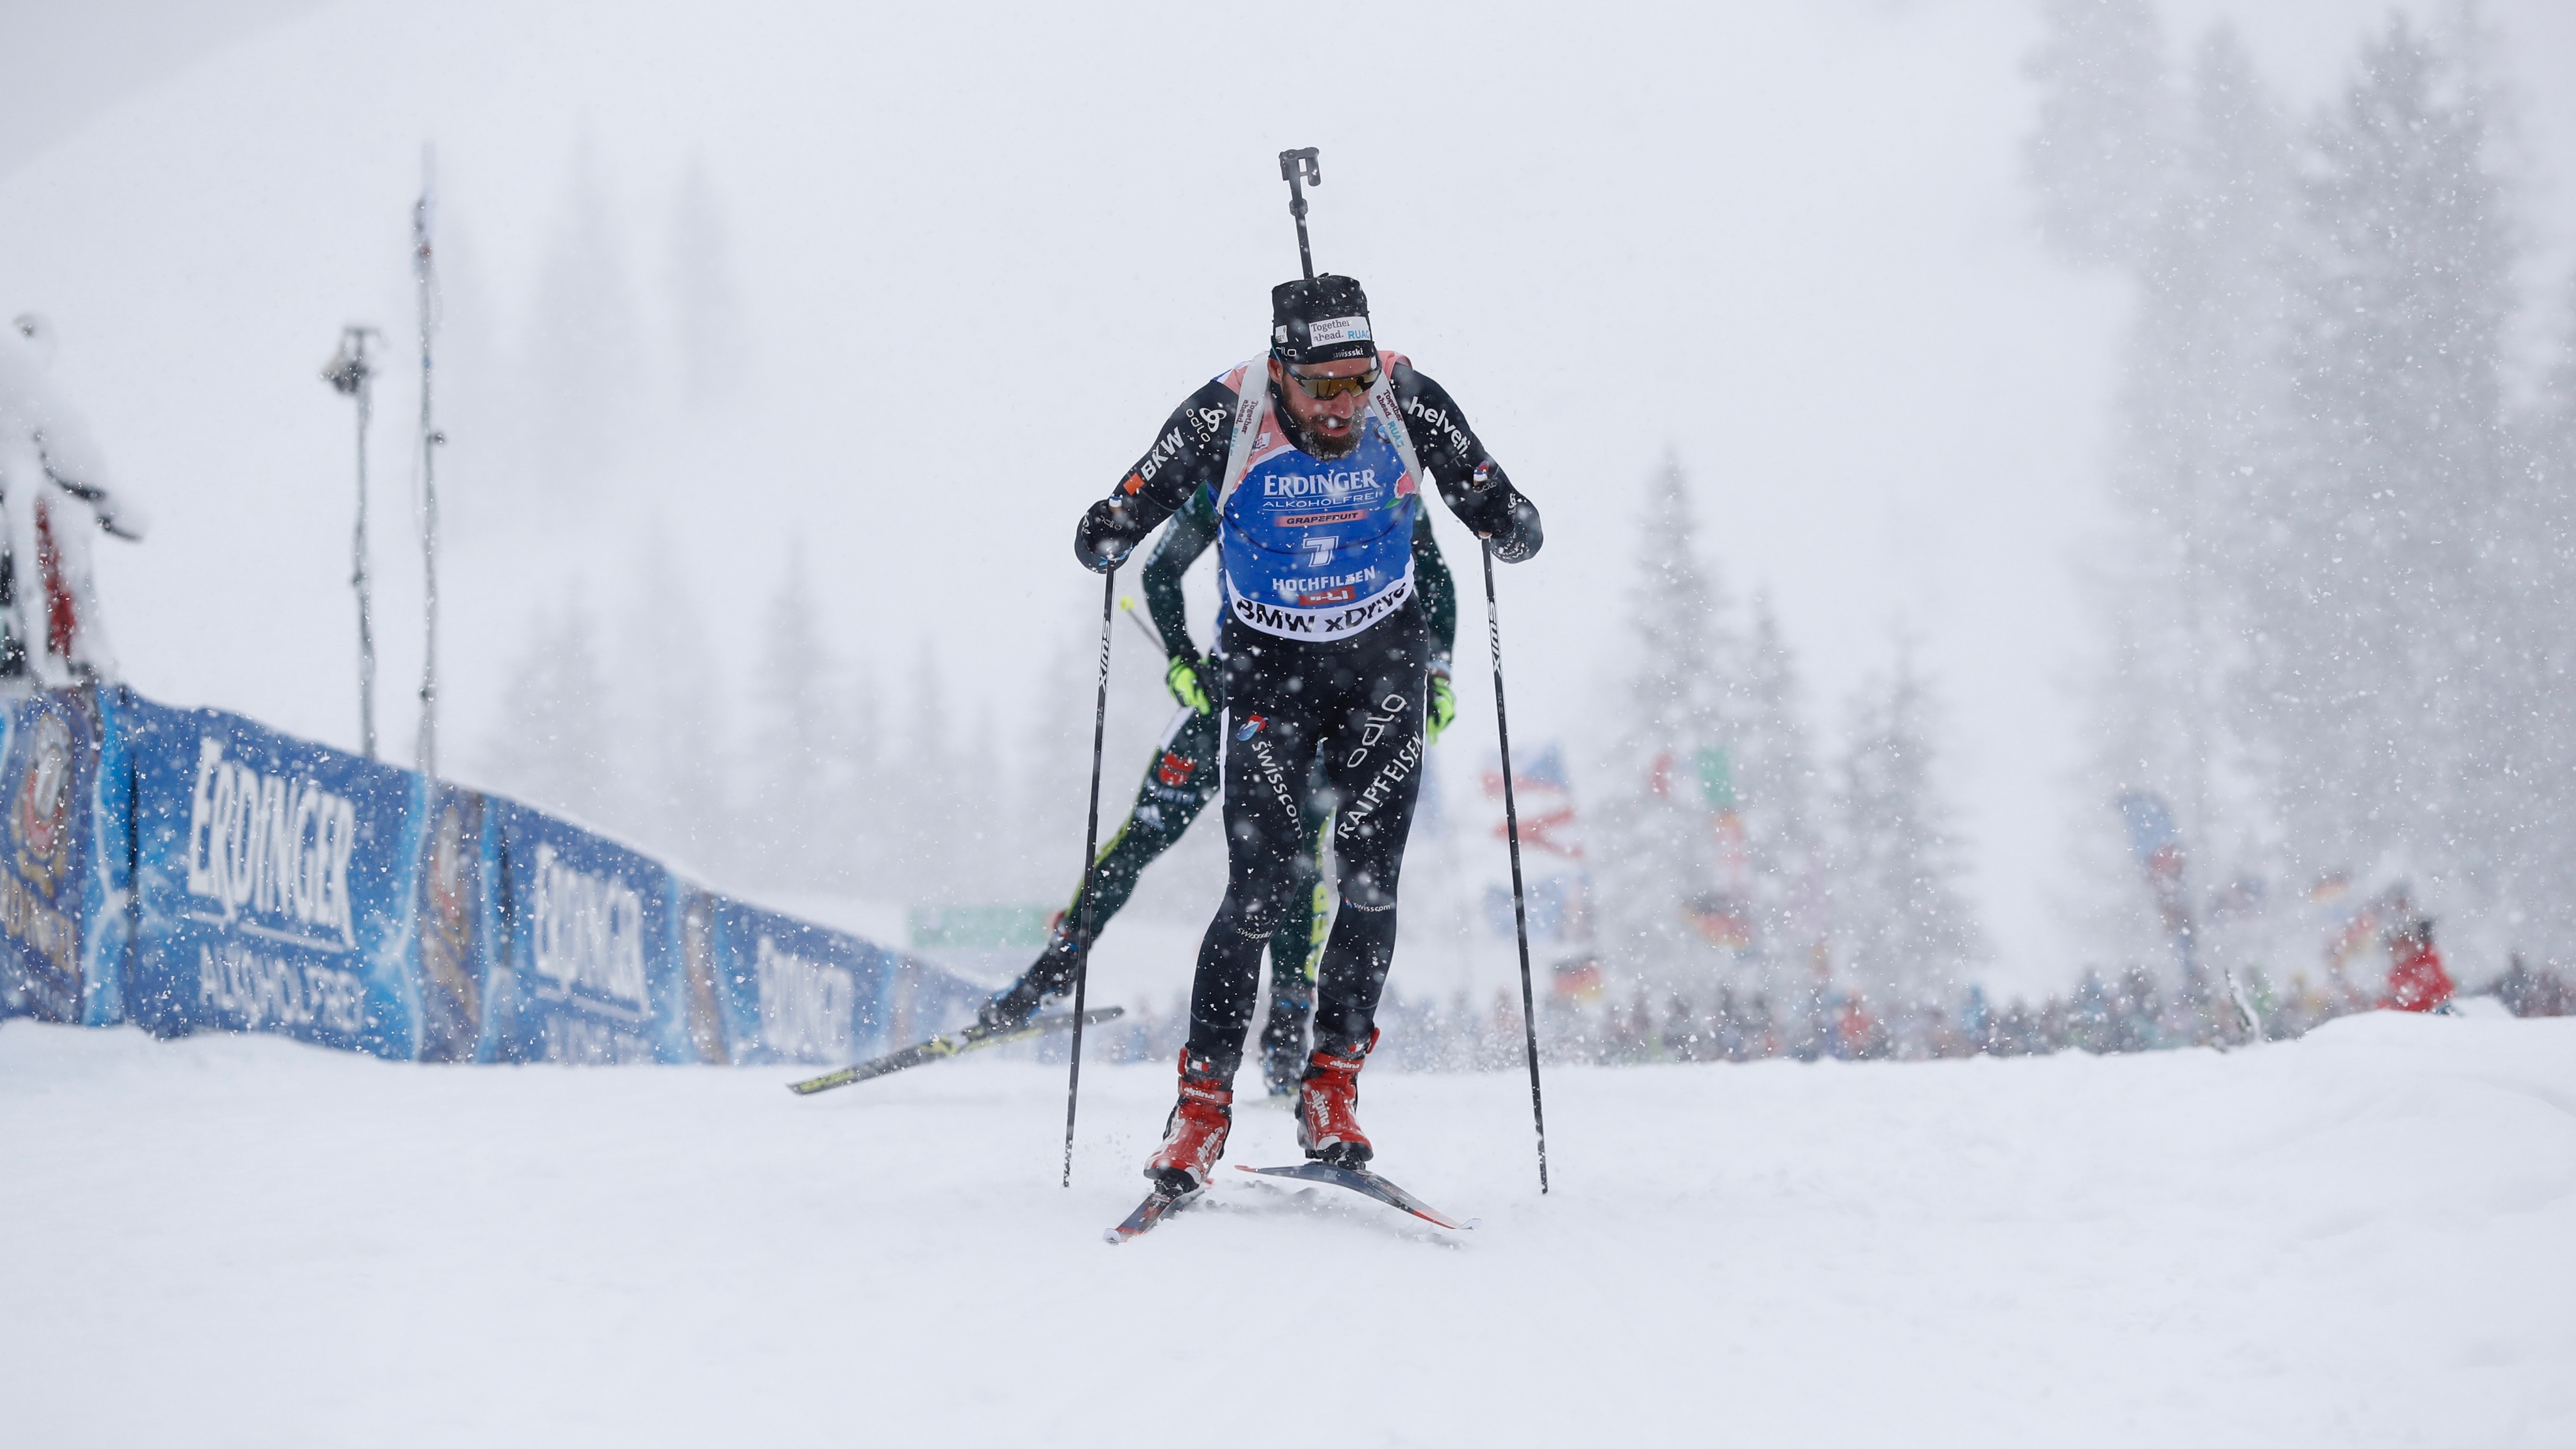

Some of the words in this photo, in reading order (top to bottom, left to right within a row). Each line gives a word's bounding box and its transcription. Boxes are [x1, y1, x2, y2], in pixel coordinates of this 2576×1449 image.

[1311, 319, 1350, 332] Together
[1313, 330, 1344, 341] ahead.
[1333, 348, 1364, 358] swissski
[1241, 401, 1258, 434] Together
[1384, 389, 1403, 421] Together
[1387, 421, 1404, 448] RUAG
[1140, 426, 1185, 481] BKW
[1263, 469, 1380, 498] ERDINGER
[1263, 492, 1379, 508] ALKOHOLFREI
[1287, 513, 1358, 525] GRAPEFRUIT
[1302, 536, 1339, 567] 7
[1236, 598, 1315, 633] BMW
[1324, 582, 1406, 632] xDrive
[1252, 741, 1303, 839] swisscom
[1337, 731, 1423, 840] RAIFFEISEN
[187, 737, 356, 947] ERDINGER
[1353, 902, 1391, 912] swisscom
[1330, 1060, 1360, 1069] alpina
[1184, 1087, 1215, 1100] alpina
[1310, 1089, 1330, 1128] alpina
[1197, 1126, 1224, 1162] alpina
